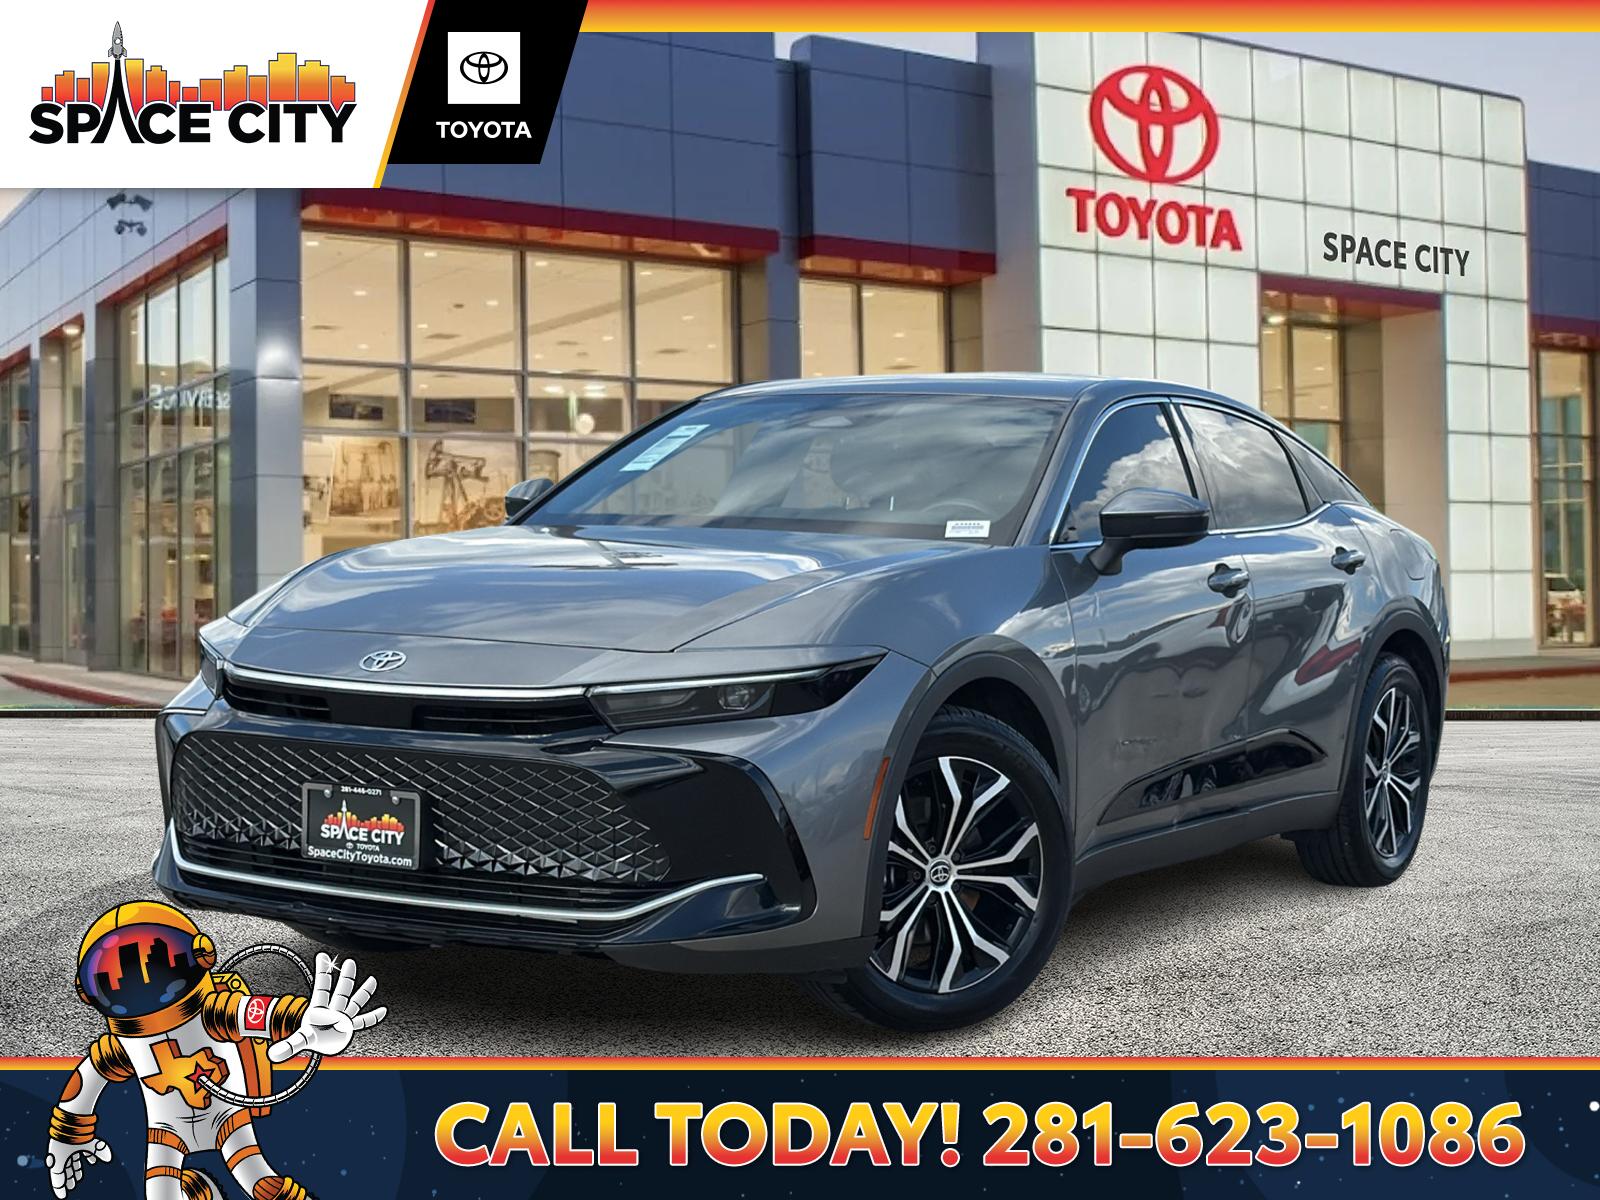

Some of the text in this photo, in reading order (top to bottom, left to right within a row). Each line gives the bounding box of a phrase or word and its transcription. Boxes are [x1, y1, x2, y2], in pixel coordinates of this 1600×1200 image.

[1065, 187, 1242, 251] TOYOTA
[1323, 232, 1470, 277] SPACE CITY
[320, 824, 405, 846] SPACE CITY
[307, 846, 412, 867] SpaceCityToyota.com
[356, 843, 380, 852] TOYOTA
